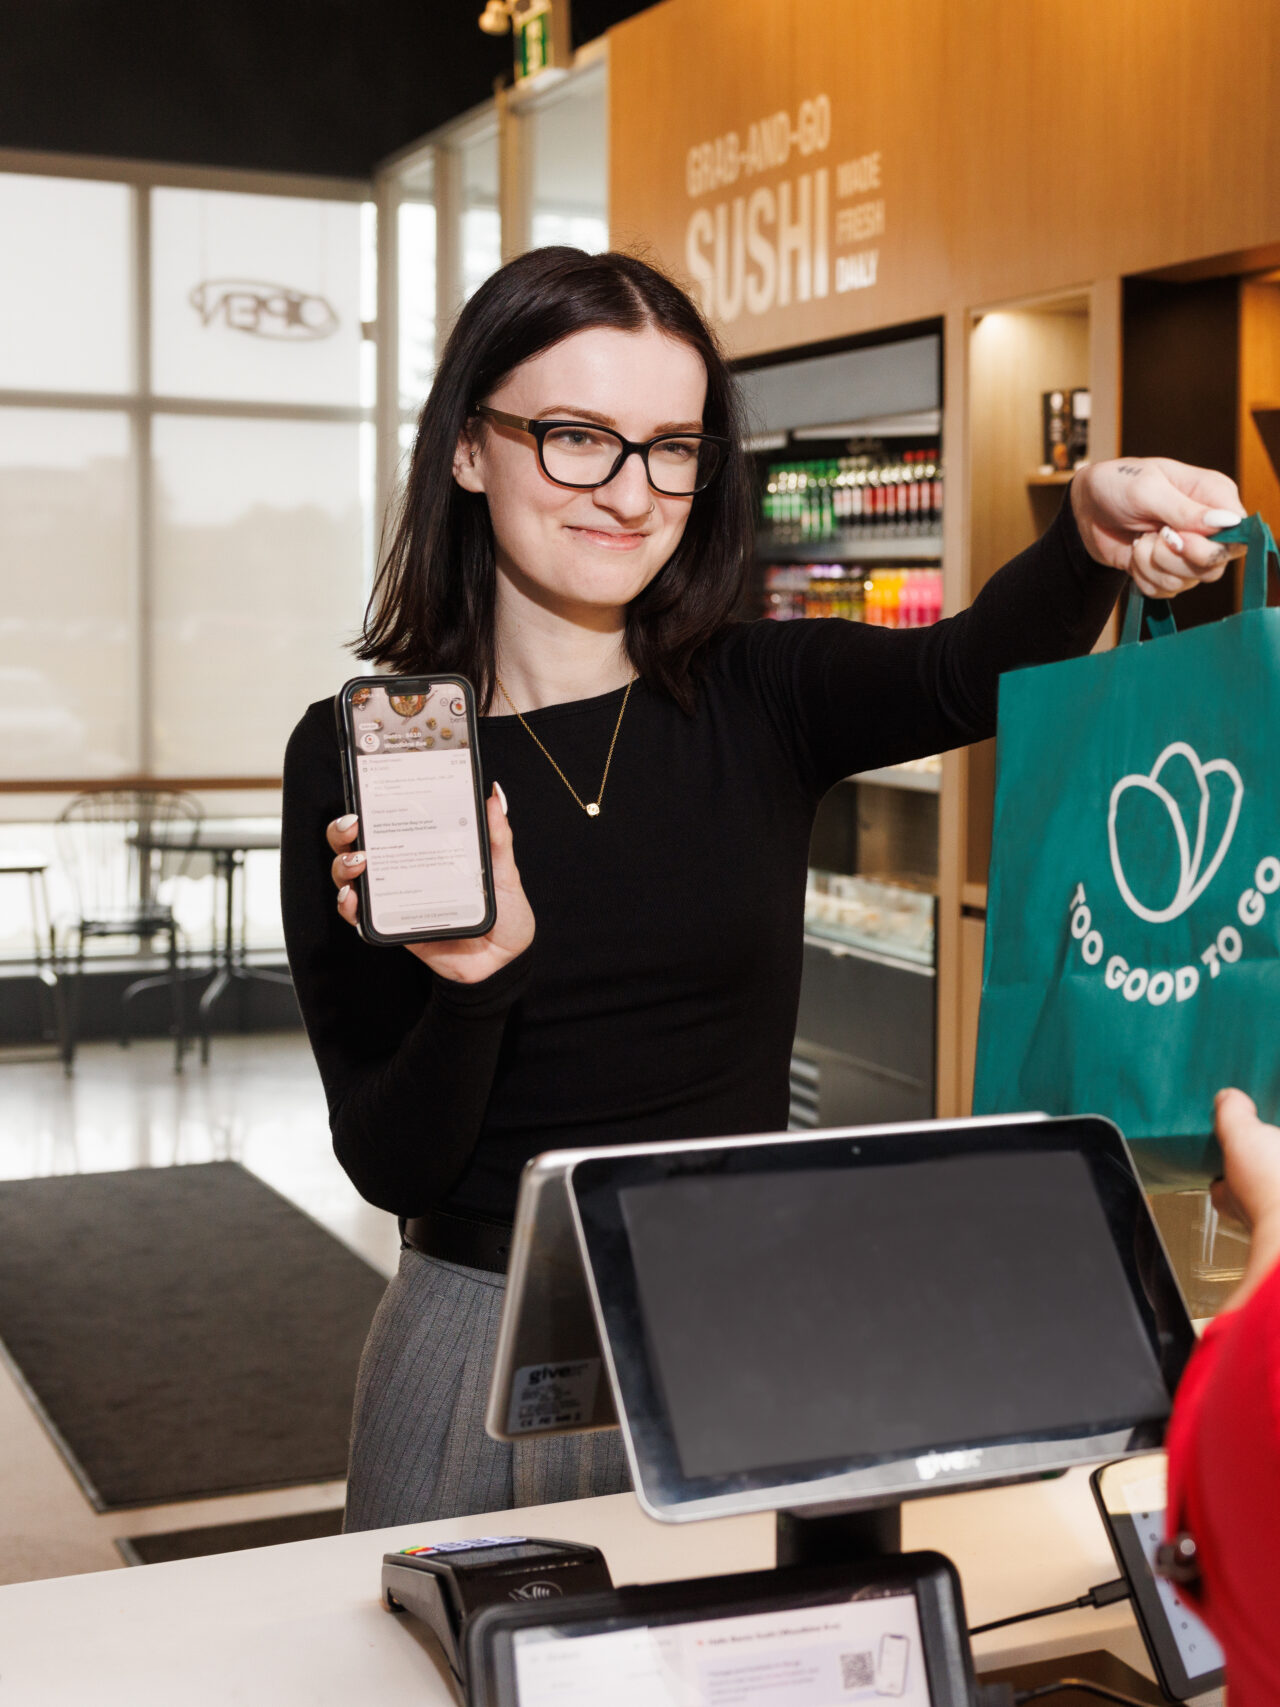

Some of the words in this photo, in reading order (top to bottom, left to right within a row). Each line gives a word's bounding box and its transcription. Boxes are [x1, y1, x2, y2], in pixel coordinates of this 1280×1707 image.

[686, 94, 831, 198] GRAB-AND-GO
[686, 167, 829, 323] SUSHI
[1069, 881, 1104, 966] TOO
[1104, 955, 1200, 1006] GOOD
[1200, 925, 1243, 979] TO
